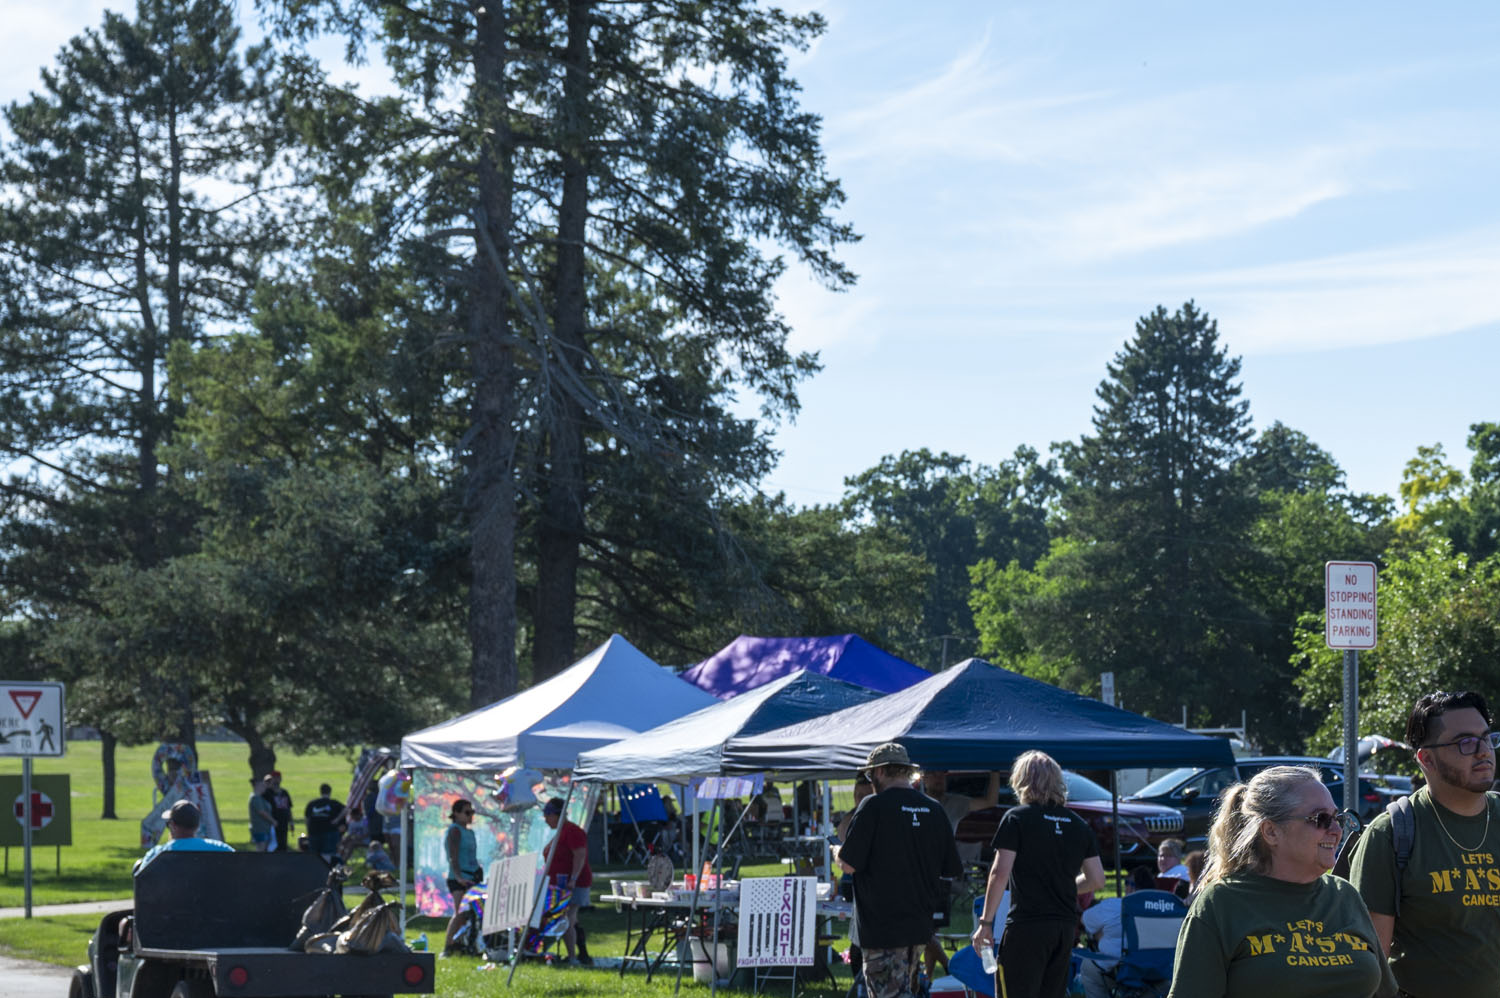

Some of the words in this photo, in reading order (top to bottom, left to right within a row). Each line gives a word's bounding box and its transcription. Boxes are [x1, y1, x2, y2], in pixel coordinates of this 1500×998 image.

[1345, 574, 1358, 586] NO
[1330, 591, 1373, 603] STOPPING
[1330, 608, 1373, 620] STANDING
[1332, 625, 1371, 637] PARKING
[1461, 853, 1495, 865] LET'S
[1144, 899, 1175, 913] meijer
[1286, 919, 1324, 933] LET'S
[760, 957, 778, 965] BACK
[780, 956, 798, 964] CLUB
[1286, 954, 1354, 967] CANCER!
